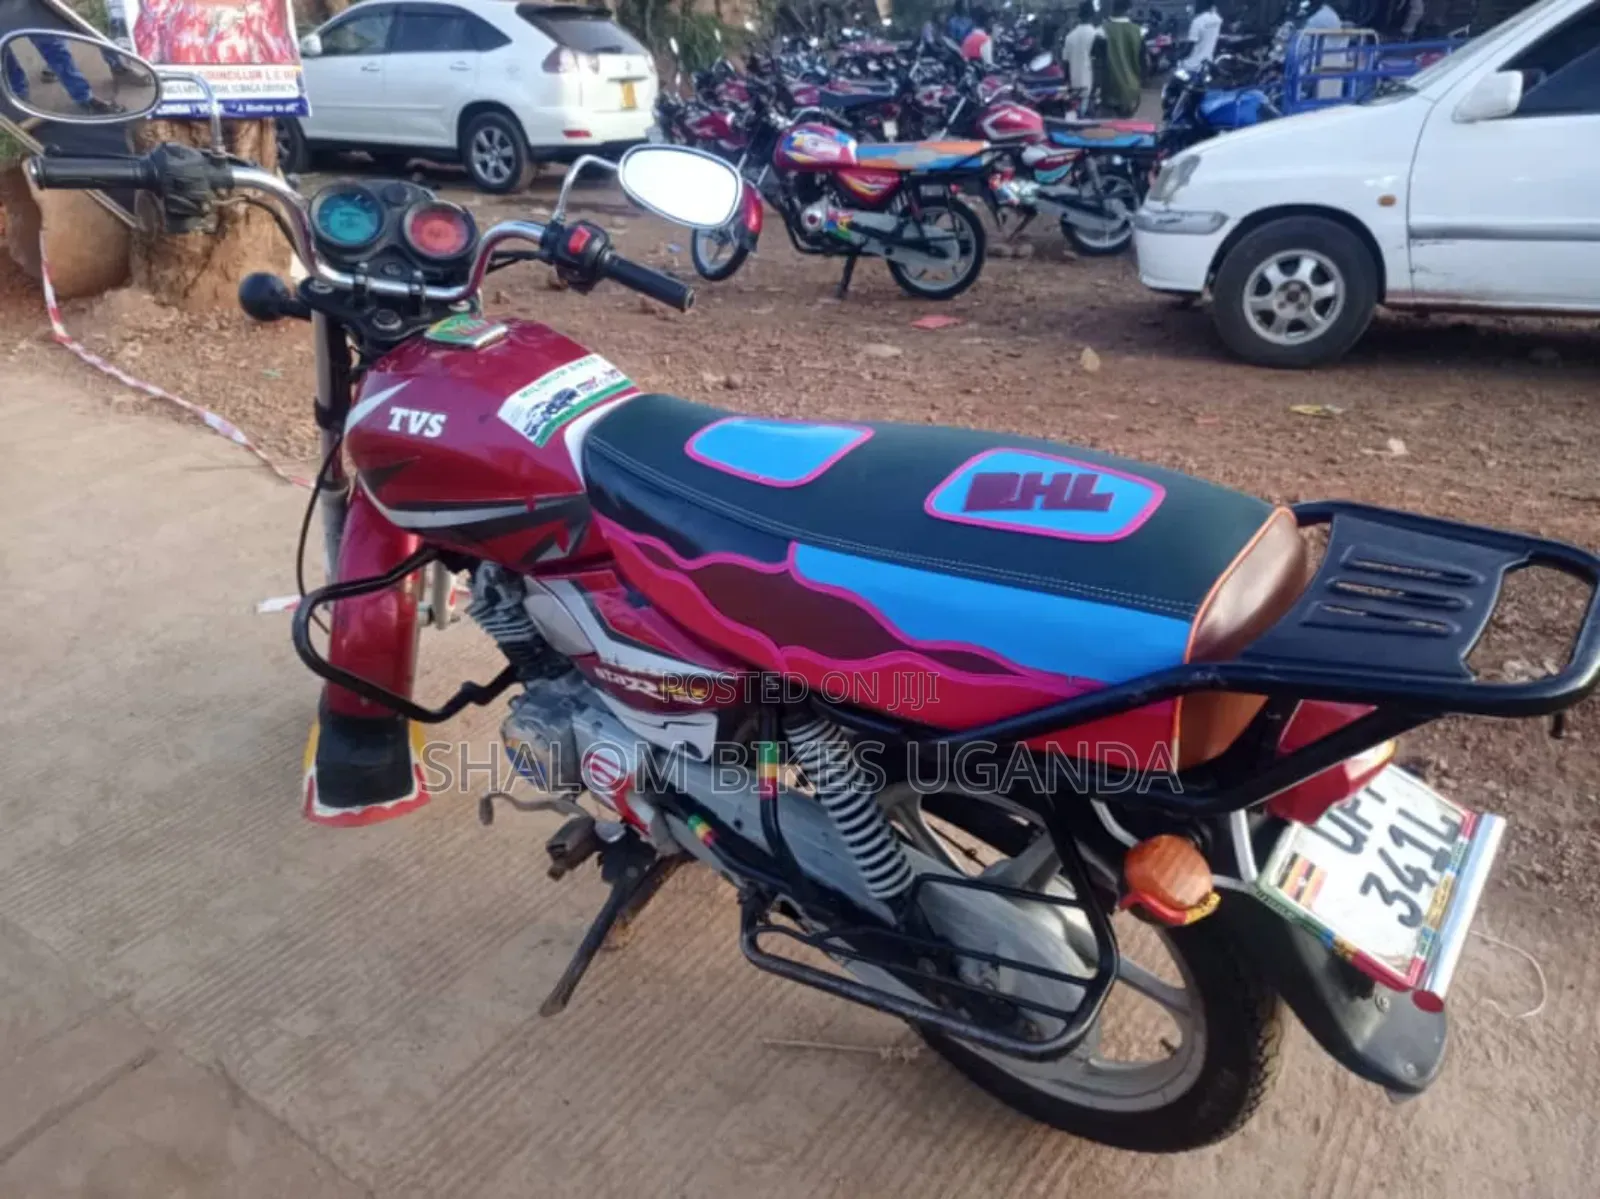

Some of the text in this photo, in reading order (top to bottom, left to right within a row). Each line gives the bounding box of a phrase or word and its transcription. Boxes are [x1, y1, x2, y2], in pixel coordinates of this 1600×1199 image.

[387, 406, 447, 438] TVS
[963, 471, 1115, 512] DHL
[1359, 807, 1462, 929] 341L
